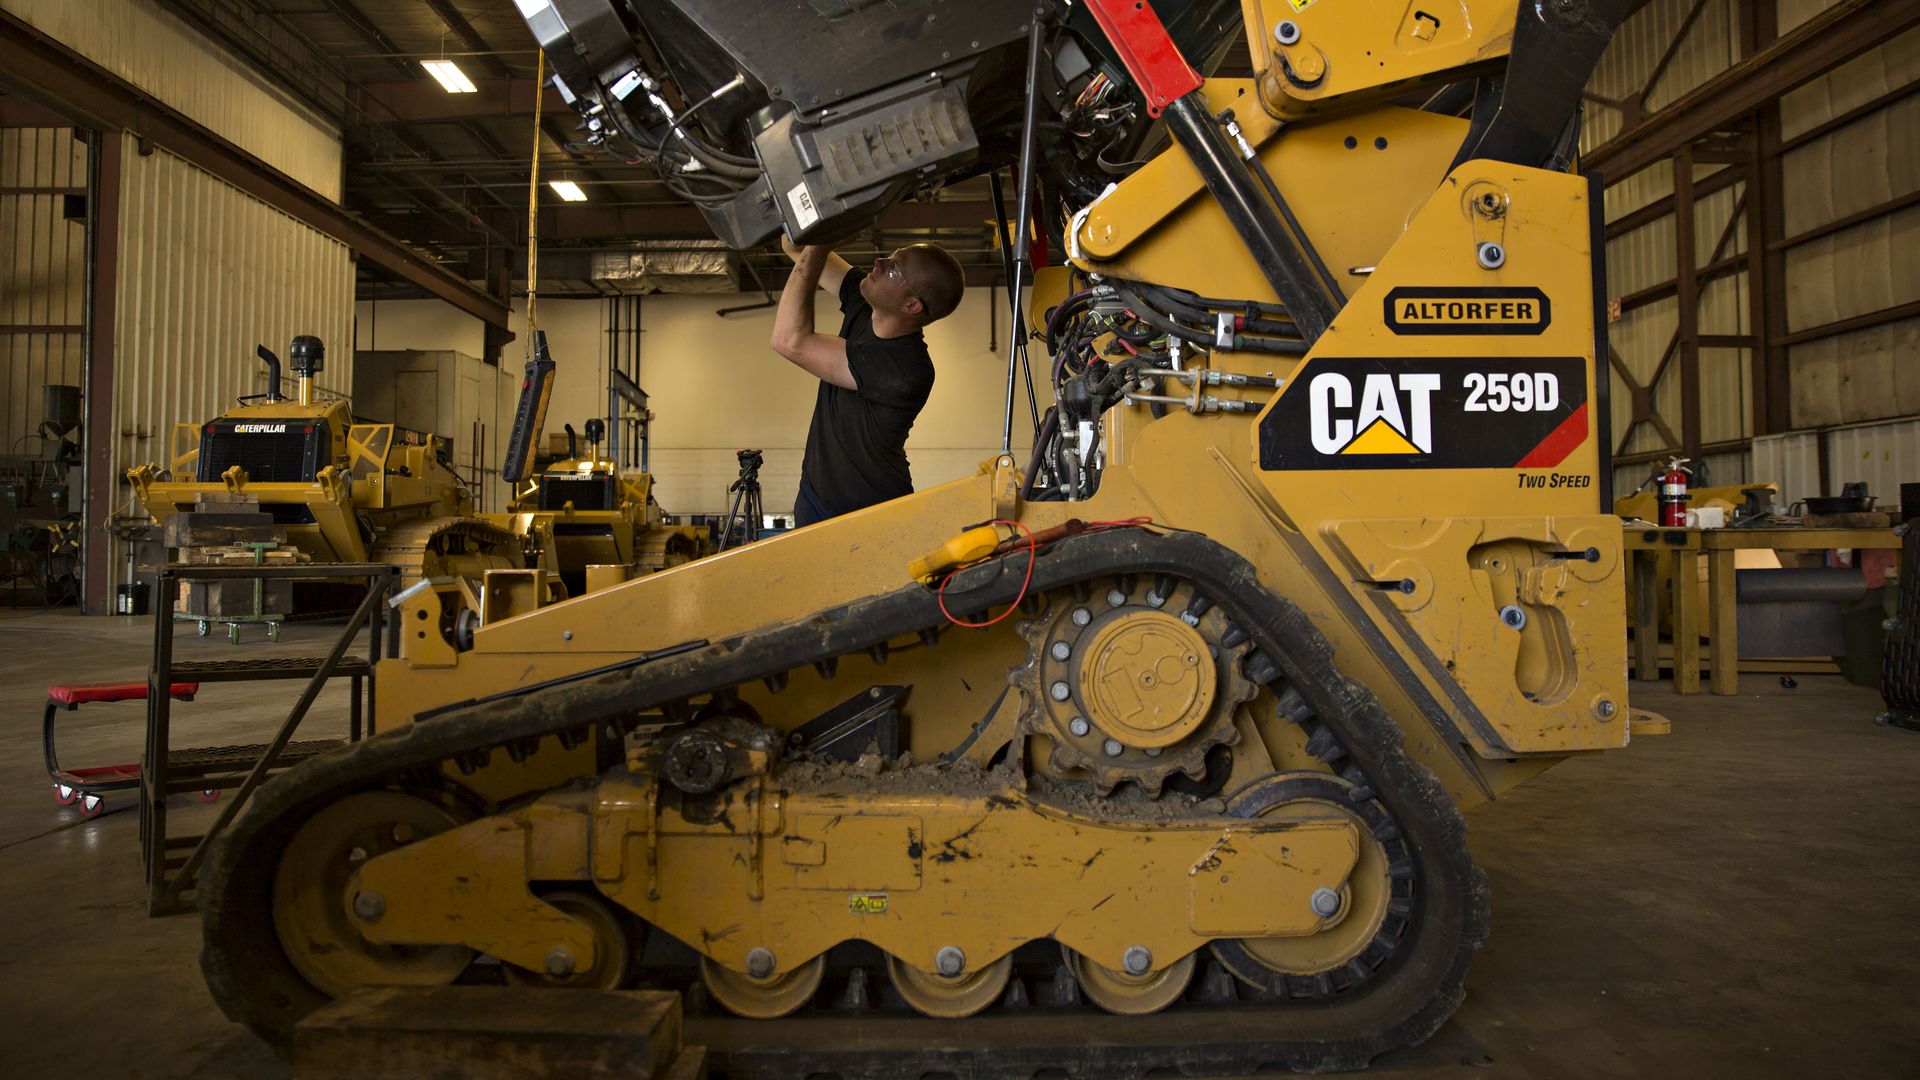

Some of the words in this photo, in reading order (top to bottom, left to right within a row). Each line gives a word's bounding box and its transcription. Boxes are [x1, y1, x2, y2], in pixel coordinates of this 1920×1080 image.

[799, 192, 813, 211] CAT
[1403, 302, 1533, 320] ALTORFER
[1309, 372, 1441, 455] CAT
[1462, 372, 1560, 413] 259D
[234, 424, 287, 433] CATERPILLAR
